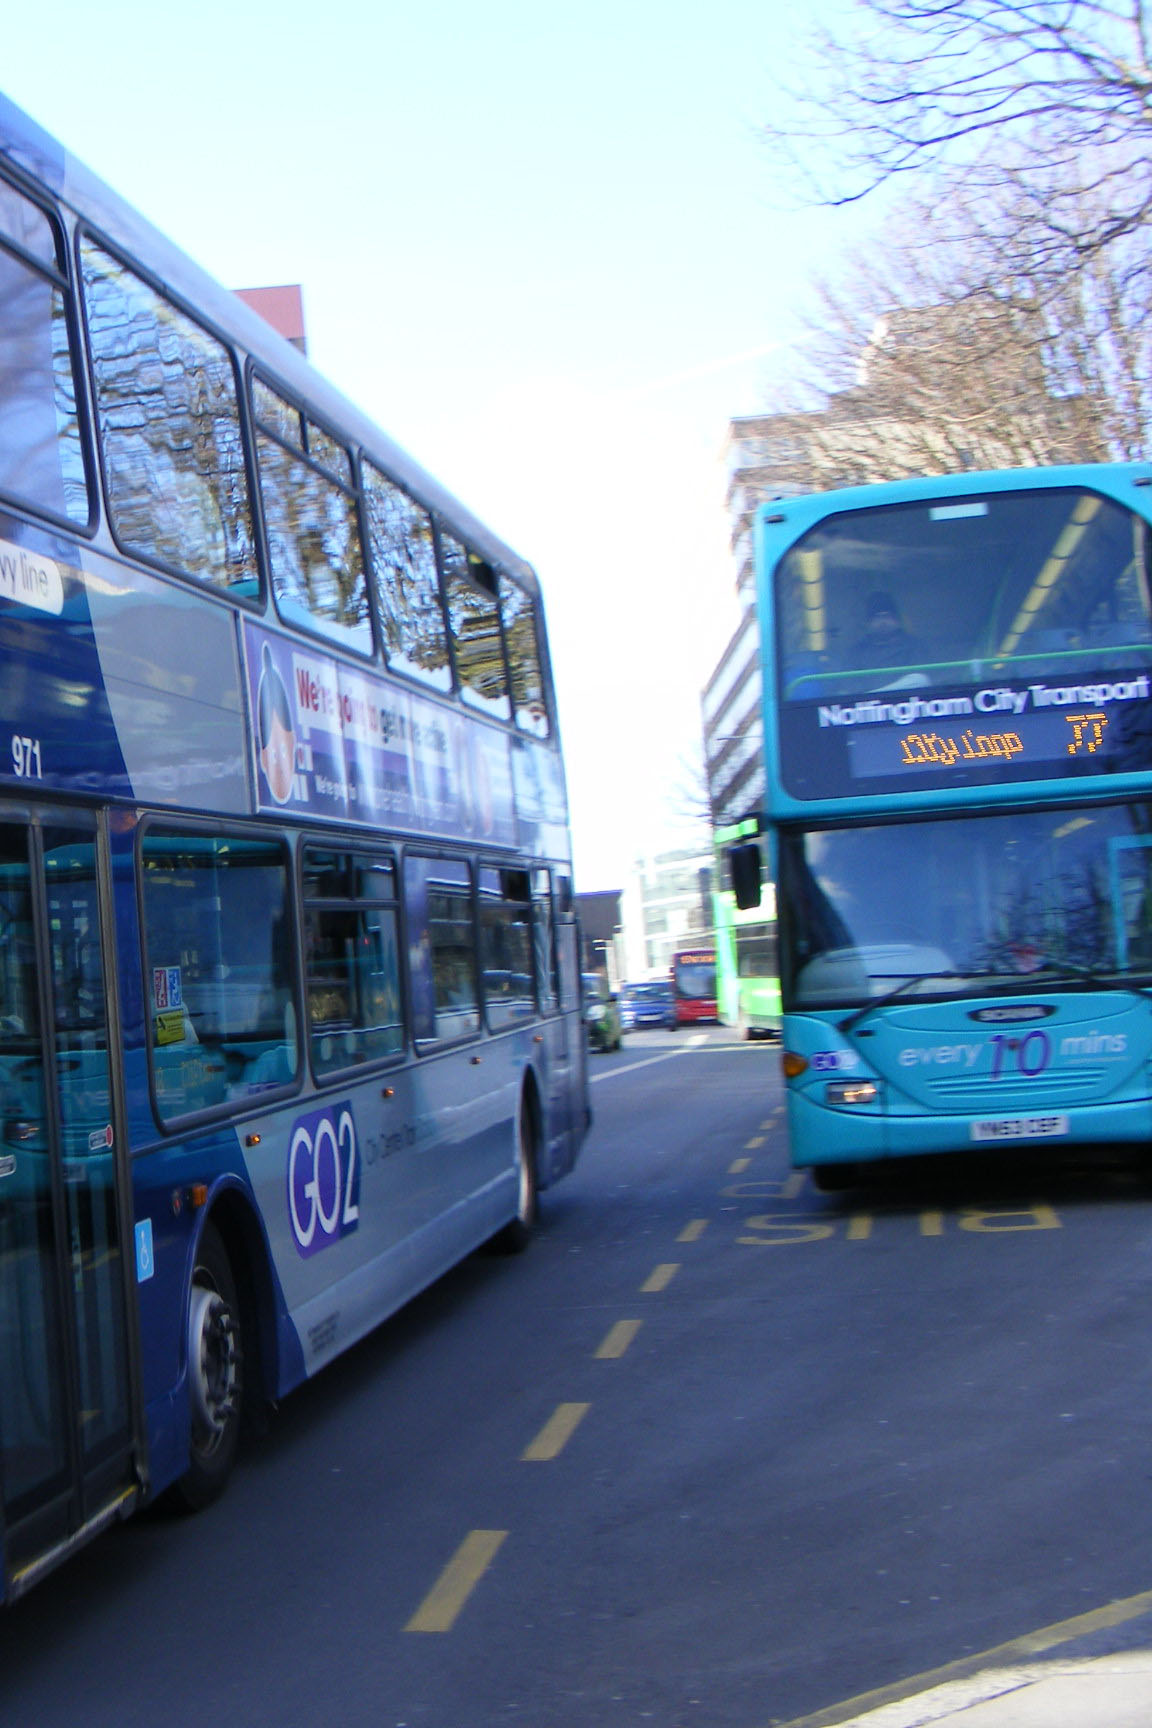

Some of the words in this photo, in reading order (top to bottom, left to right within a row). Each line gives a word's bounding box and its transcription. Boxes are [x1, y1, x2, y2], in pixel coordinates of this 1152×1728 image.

[19, 556, 49, 598] line
[818, 694, 973, 729] Nottingham
[974, 687, 1029, 716] City
[1029, 675, 1149, 709] Transport
[1064, 712, 1109, 755] 77
[11, 734, 43, 779] 971
[899, 1043, 984, 1067] every
[1059, 1030, 1128, 1057] mins
[288, 1110, 360, 1248] GO2
